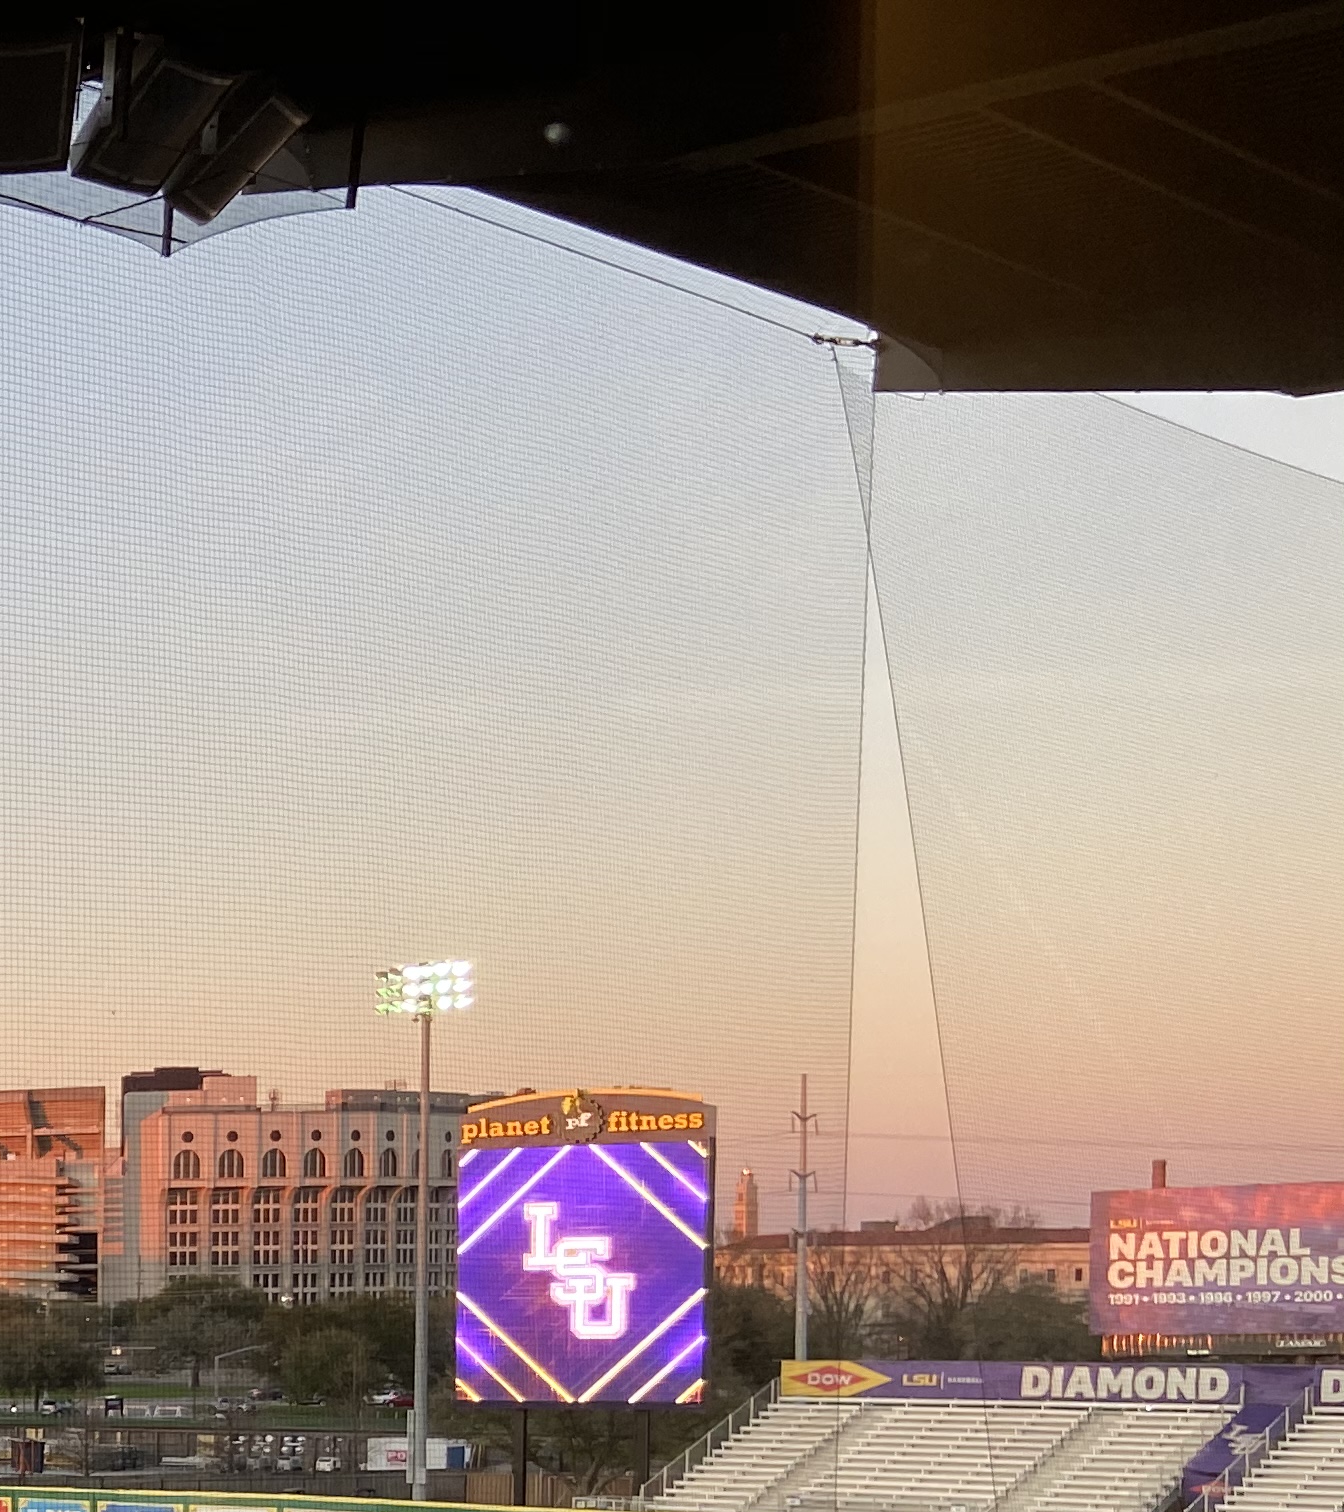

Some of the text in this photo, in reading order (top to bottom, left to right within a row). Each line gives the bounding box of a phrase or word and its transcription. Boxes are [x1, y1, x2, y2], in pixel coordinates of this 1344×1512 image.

[462, 1110, 703, 1144] planet fitness
[1109, 1228, 1311, 1260] NATIONAL
[523, 1201, 637, 1339] LSU
[1108, 1293, 1140, 1305] 1991
[1246, 1291, 1281, 1303] 1997
[1294, 1290, 1333, 1302] 2000
[807, 1373, 852, 1386] DOW
[903, 1373, 938, 1387] LSU
[1021, 1365, 1229, 1400] DIAMOND
